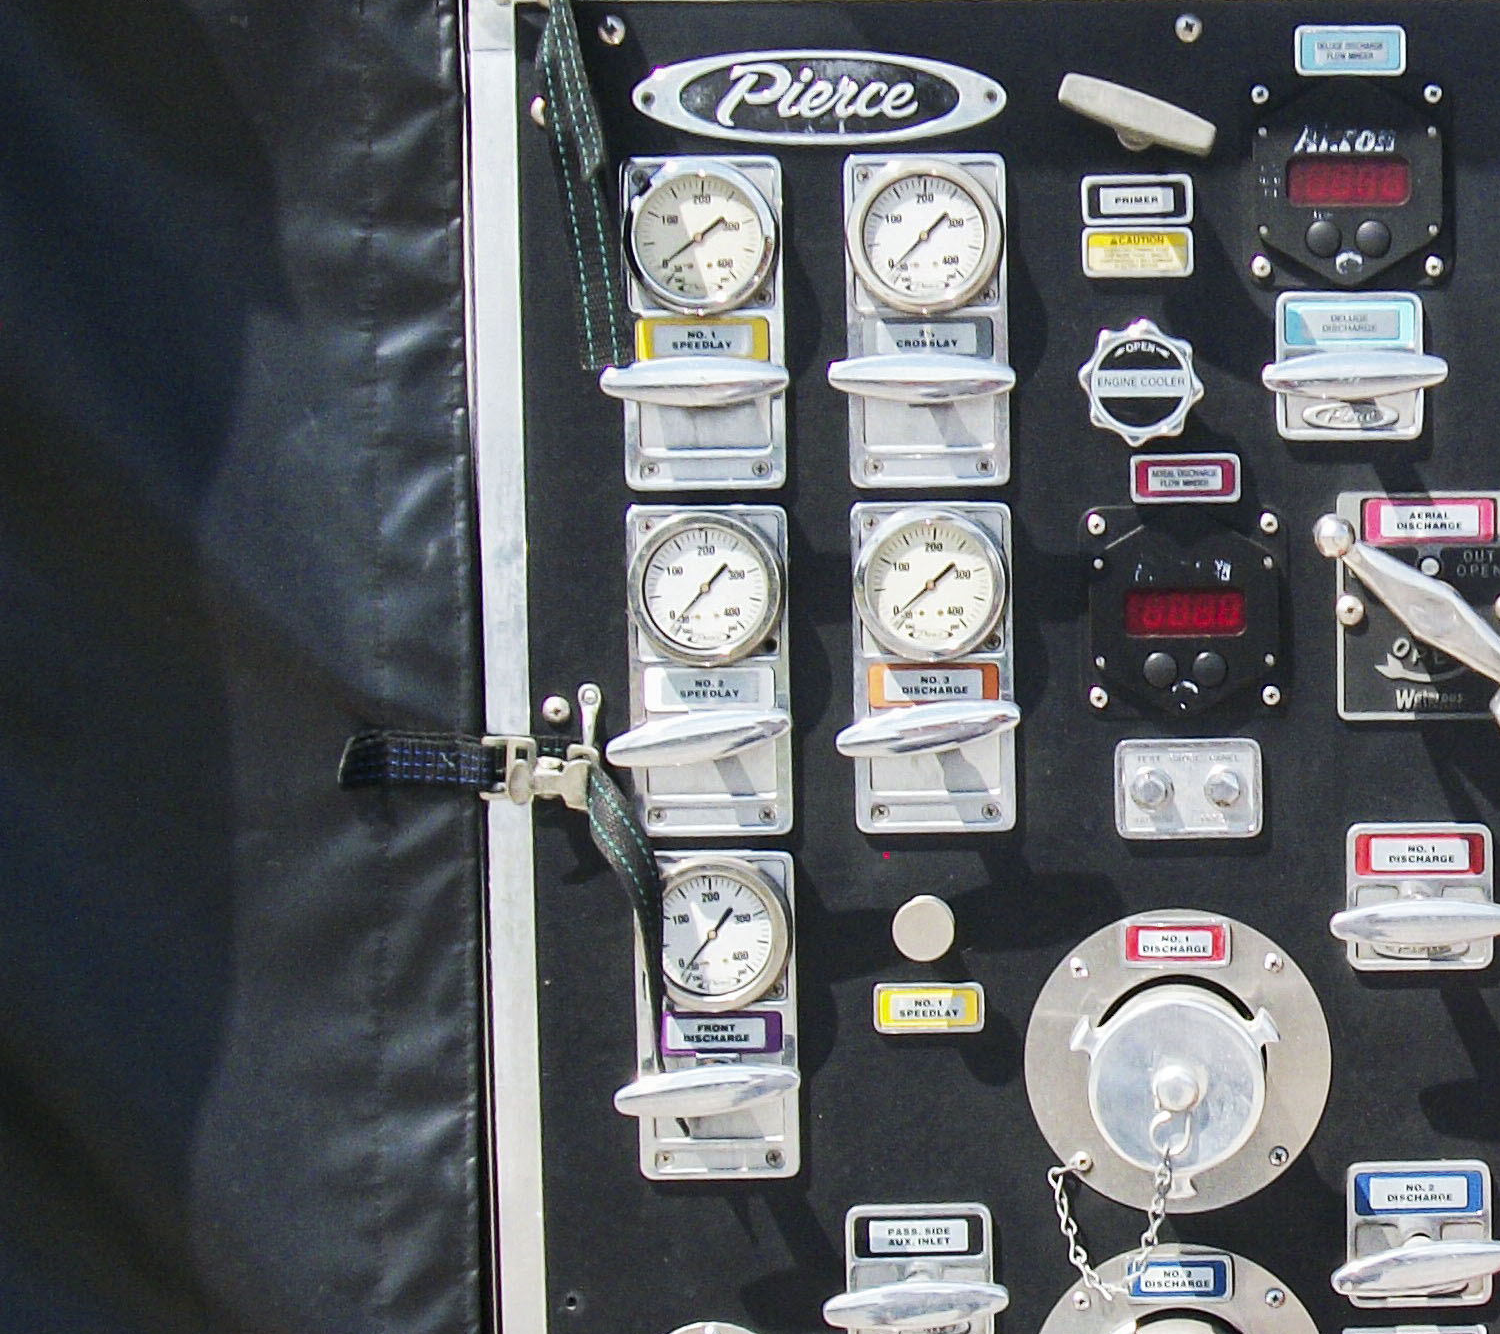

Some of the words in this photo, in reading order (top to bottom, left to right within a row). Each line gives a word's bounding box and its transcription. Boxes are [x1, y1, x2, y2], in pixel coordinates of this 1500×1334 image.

[716, 62, 920, 128] Pierce
[1115, 196, 1158, 204] PRIMER
[1120, 235, 1164, 245] CAUTION
[687, 331, 708, 339] NO.
[672, 340, 732, 349] SPEEDLAY
[896, 339, 958, 348] CROSSLAY
[1125, 342, 1156, 354] OPEN
[1098, 377, 1137, 387] ENGINE
[1140, 376, 1186, 387] COOLER
[1396, 522, 1463, 530] DISCHARGE
[1463, 551, 1496, 561] OUT
[695, 679, 714, 688] NO.
[718, 679, 724, 687] 2
[920, 676, 940, 684] NO.
[943, 676, 950, 684] 3
[680, 689, 740, 698] SPEEDLAY
[901, 685, 969, 695] DISCHARGE
[1408, 845, 1428, 853] NO.
[1388, 855, 1455, 863] DISCHARGE
[701, 892, 720, 903] 200
[671, 914, 689, 925] 100
[1160, 935, 1181, 943] NO.
[1143, 944, 1209, 954] DISCHARGE
[914, 1000, 934, 1008] NO.
[899, 1009, 960, 1018] SPEEDLAY
[697, 1024, 736, 1033] FRONT
[683, 1033, 750, 1043] DISCHARGE
[1406, 1184, 1426, 1192] NO.
[1428, 1184, 1435, 1192] 2
[1387, 1194, 1453, 1203] DISCHARGE
[888, 1238, 912, 1246] AUX.
[918, 1237, 950, 1245] INLET
[1163, 1270, 1183, 1278] NO.
[1186, 1270, 1193, 1278] 2
[1144, 1279, 1211, 1289] DISCHARGE
